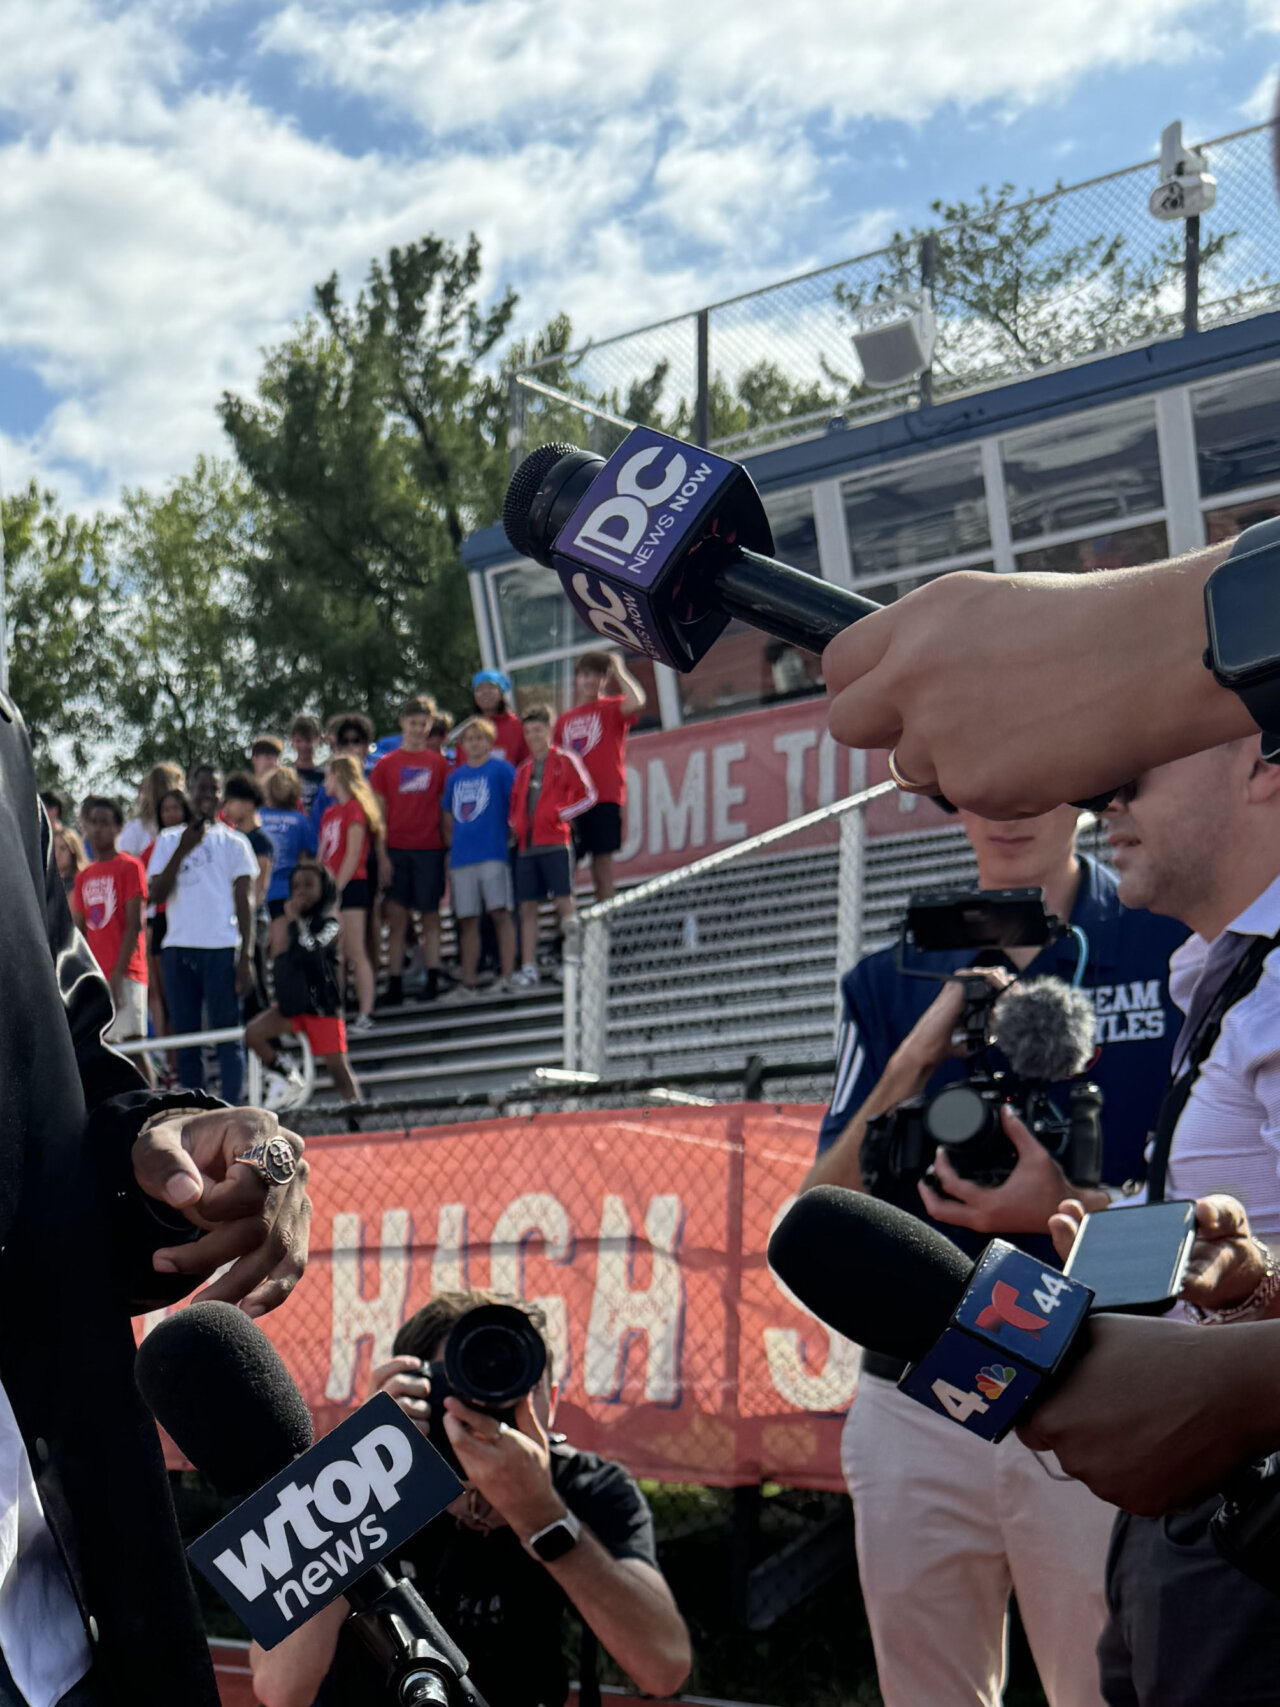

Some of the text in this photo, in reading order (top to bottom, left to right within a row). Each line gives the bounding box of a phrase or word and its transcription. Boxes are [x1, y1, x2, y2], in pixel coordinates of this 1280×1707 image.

[573, 446, 687, 566] DC
[627, 462, 713, 574] NEWS NOW
[622, 591, 645, 629] NOW
[1032, 1272, 1073, 1314] 44
[931, 1378, 990, 1423] 4
[212, 1424, 413, 1603] wtop
[272, 1513, 388, 1622] news
